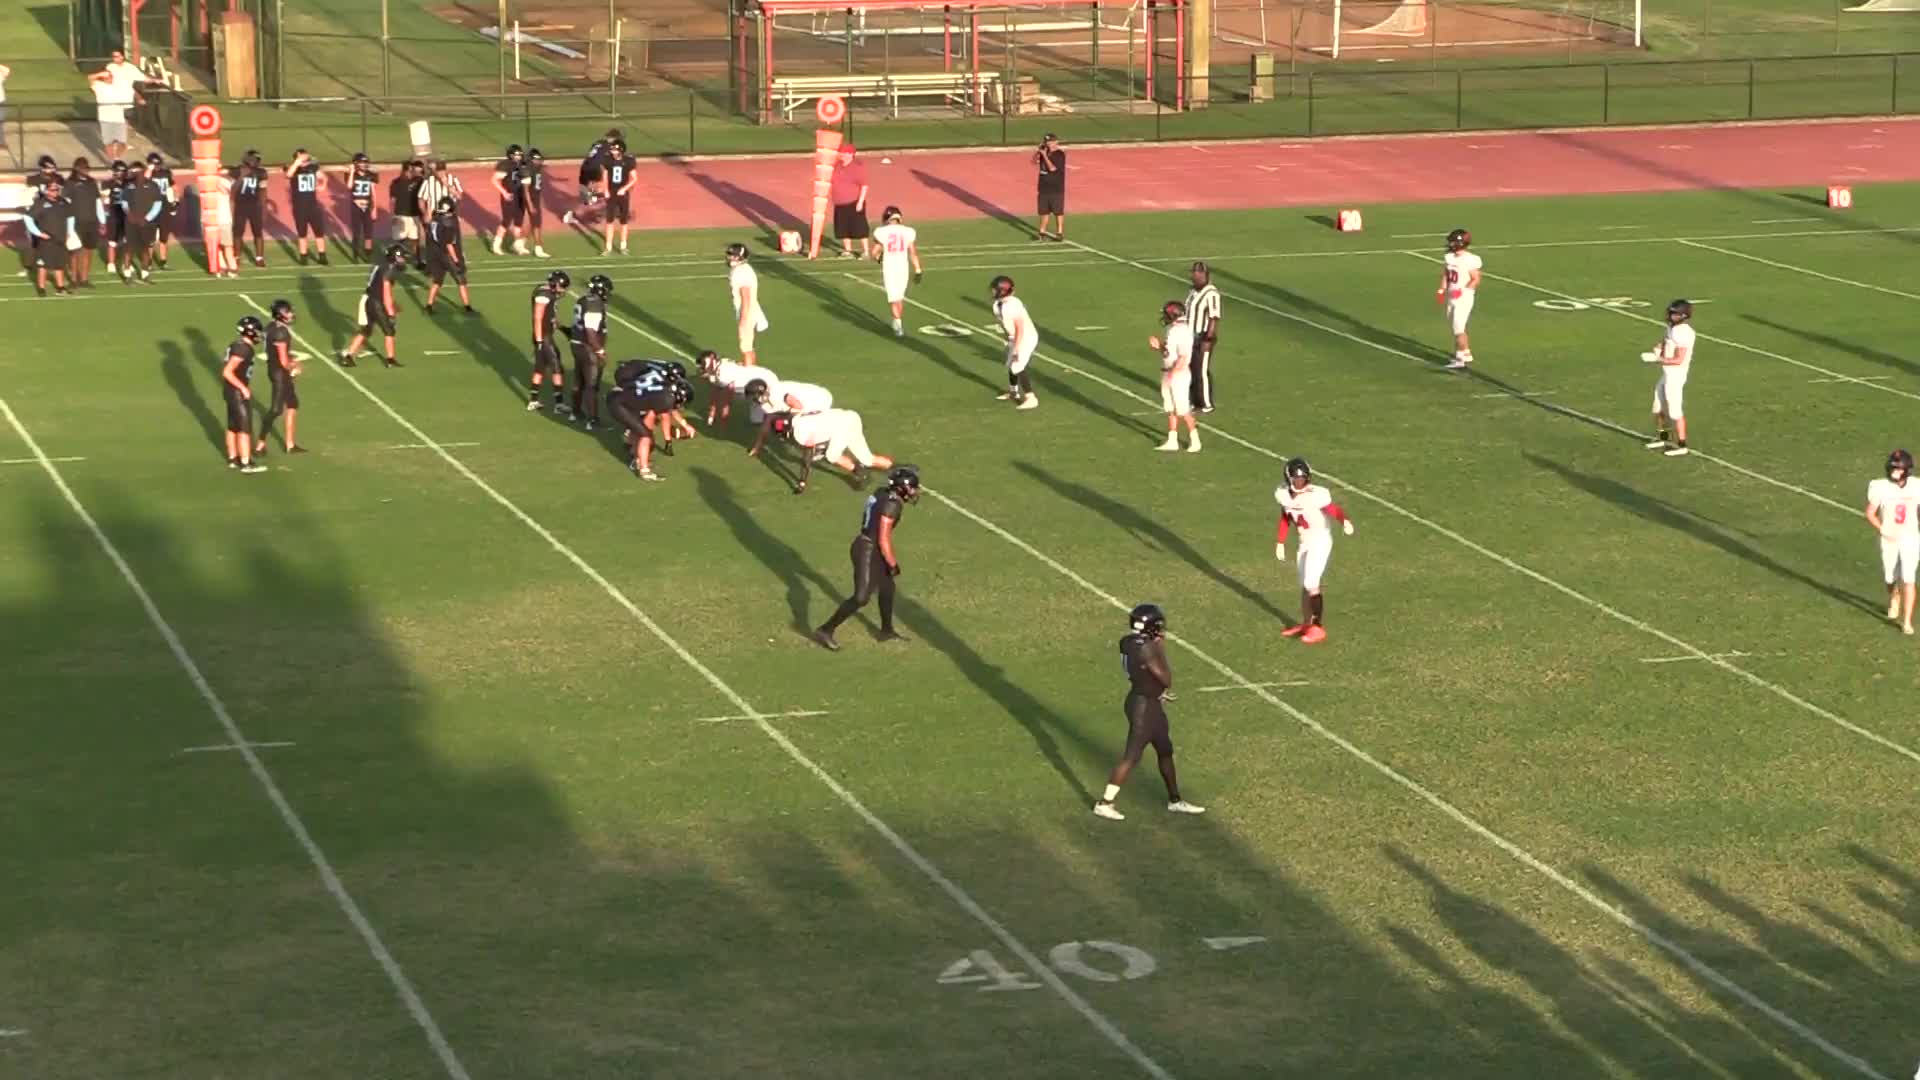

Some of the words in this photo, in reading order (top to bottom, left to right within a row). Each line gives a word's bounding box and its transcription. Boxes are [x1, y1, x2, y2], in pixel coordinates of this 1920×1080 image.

[297, 174, 314, 192] 60
[612, 166, 623, 184] 8
[1830, 188, 1850, 208] 10
[1341, 210, 1362, 231] 20
[887, 234, 905, 252] 21
[935, 940, 1156, 992] 40
